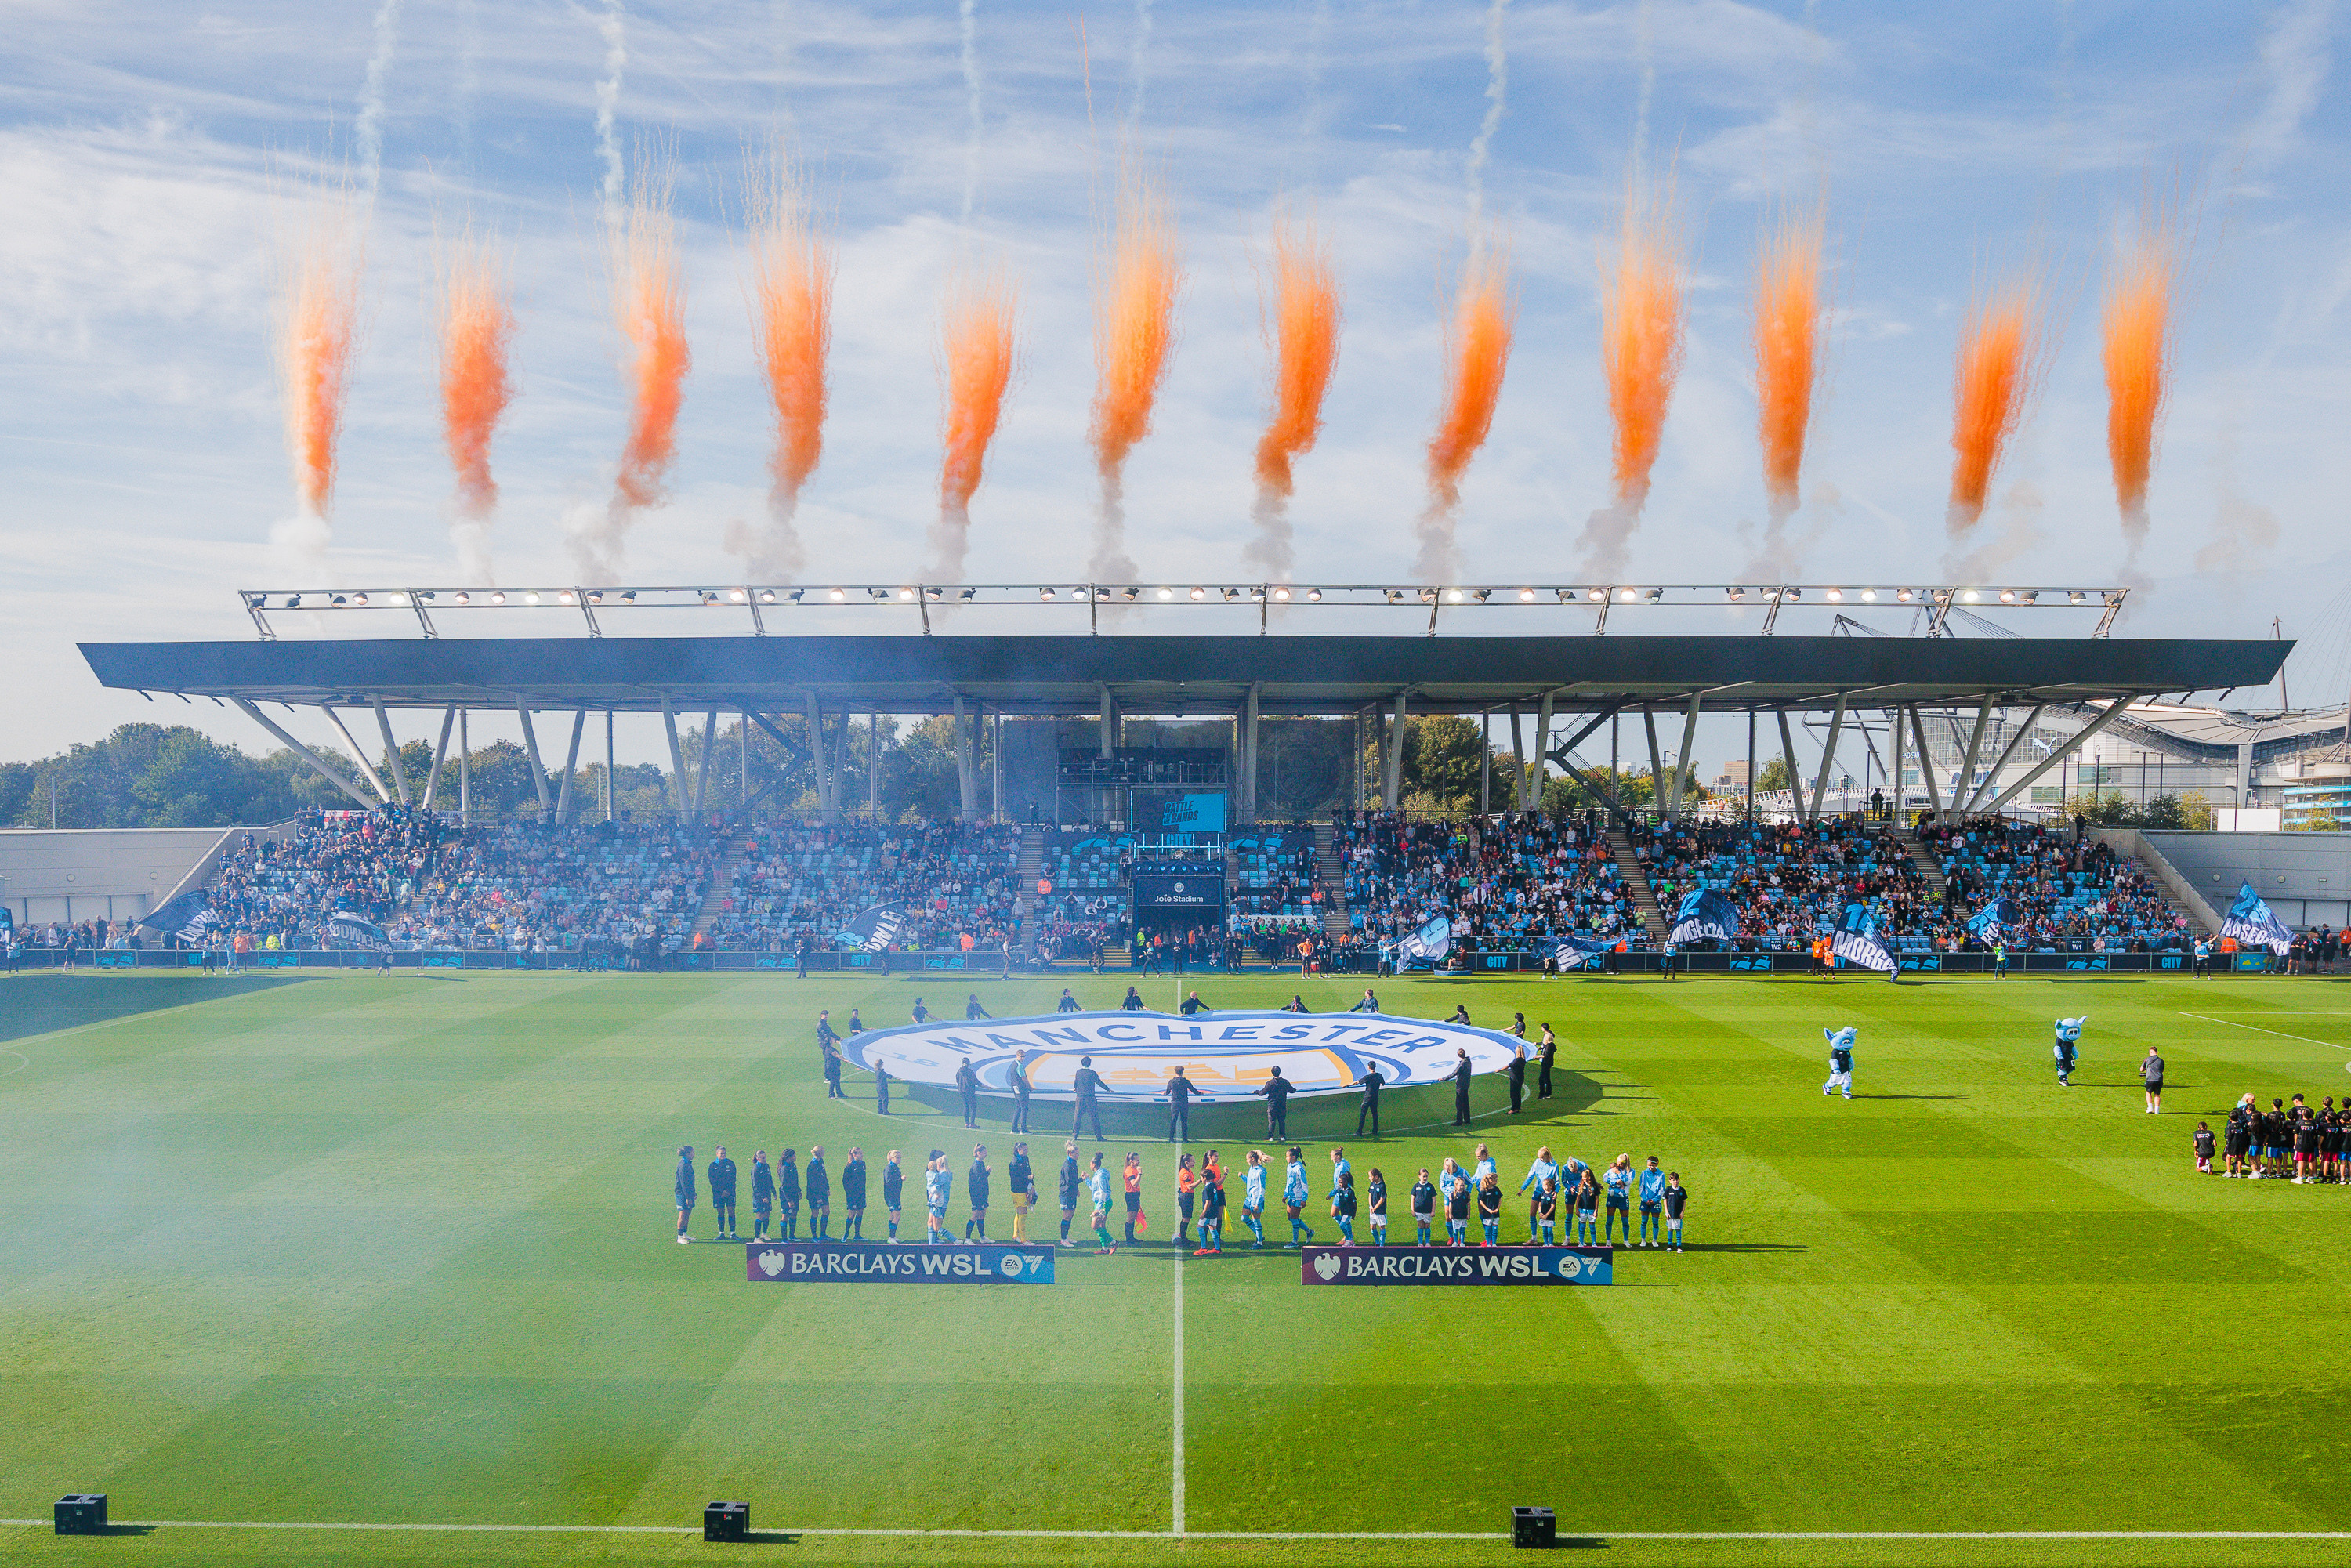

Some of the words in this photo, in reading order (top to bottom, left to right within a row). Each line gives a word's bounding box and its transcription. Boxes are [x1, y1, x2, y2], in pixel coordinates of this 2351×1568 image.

[1165, 801, 1194, 813] BATTLE
[1171, 810, 1198, 823] BANDS
[188, 953, 202, 965] CIT
[851, 954, 871, 966] CITY
[1487, 956, 1508, 968] CITY
[2161, 957, 2183, 969] CITY
[925, 1023, 1447, 1055] MANCHESTER
[792, 1254, 915, 1274] BARCLAYS
[921, 1254, 991, 1276] WSL
[1346, 1256, 1473, 1277] BARCLAYS
[1478, 1255, 1549, 1277] WSL
